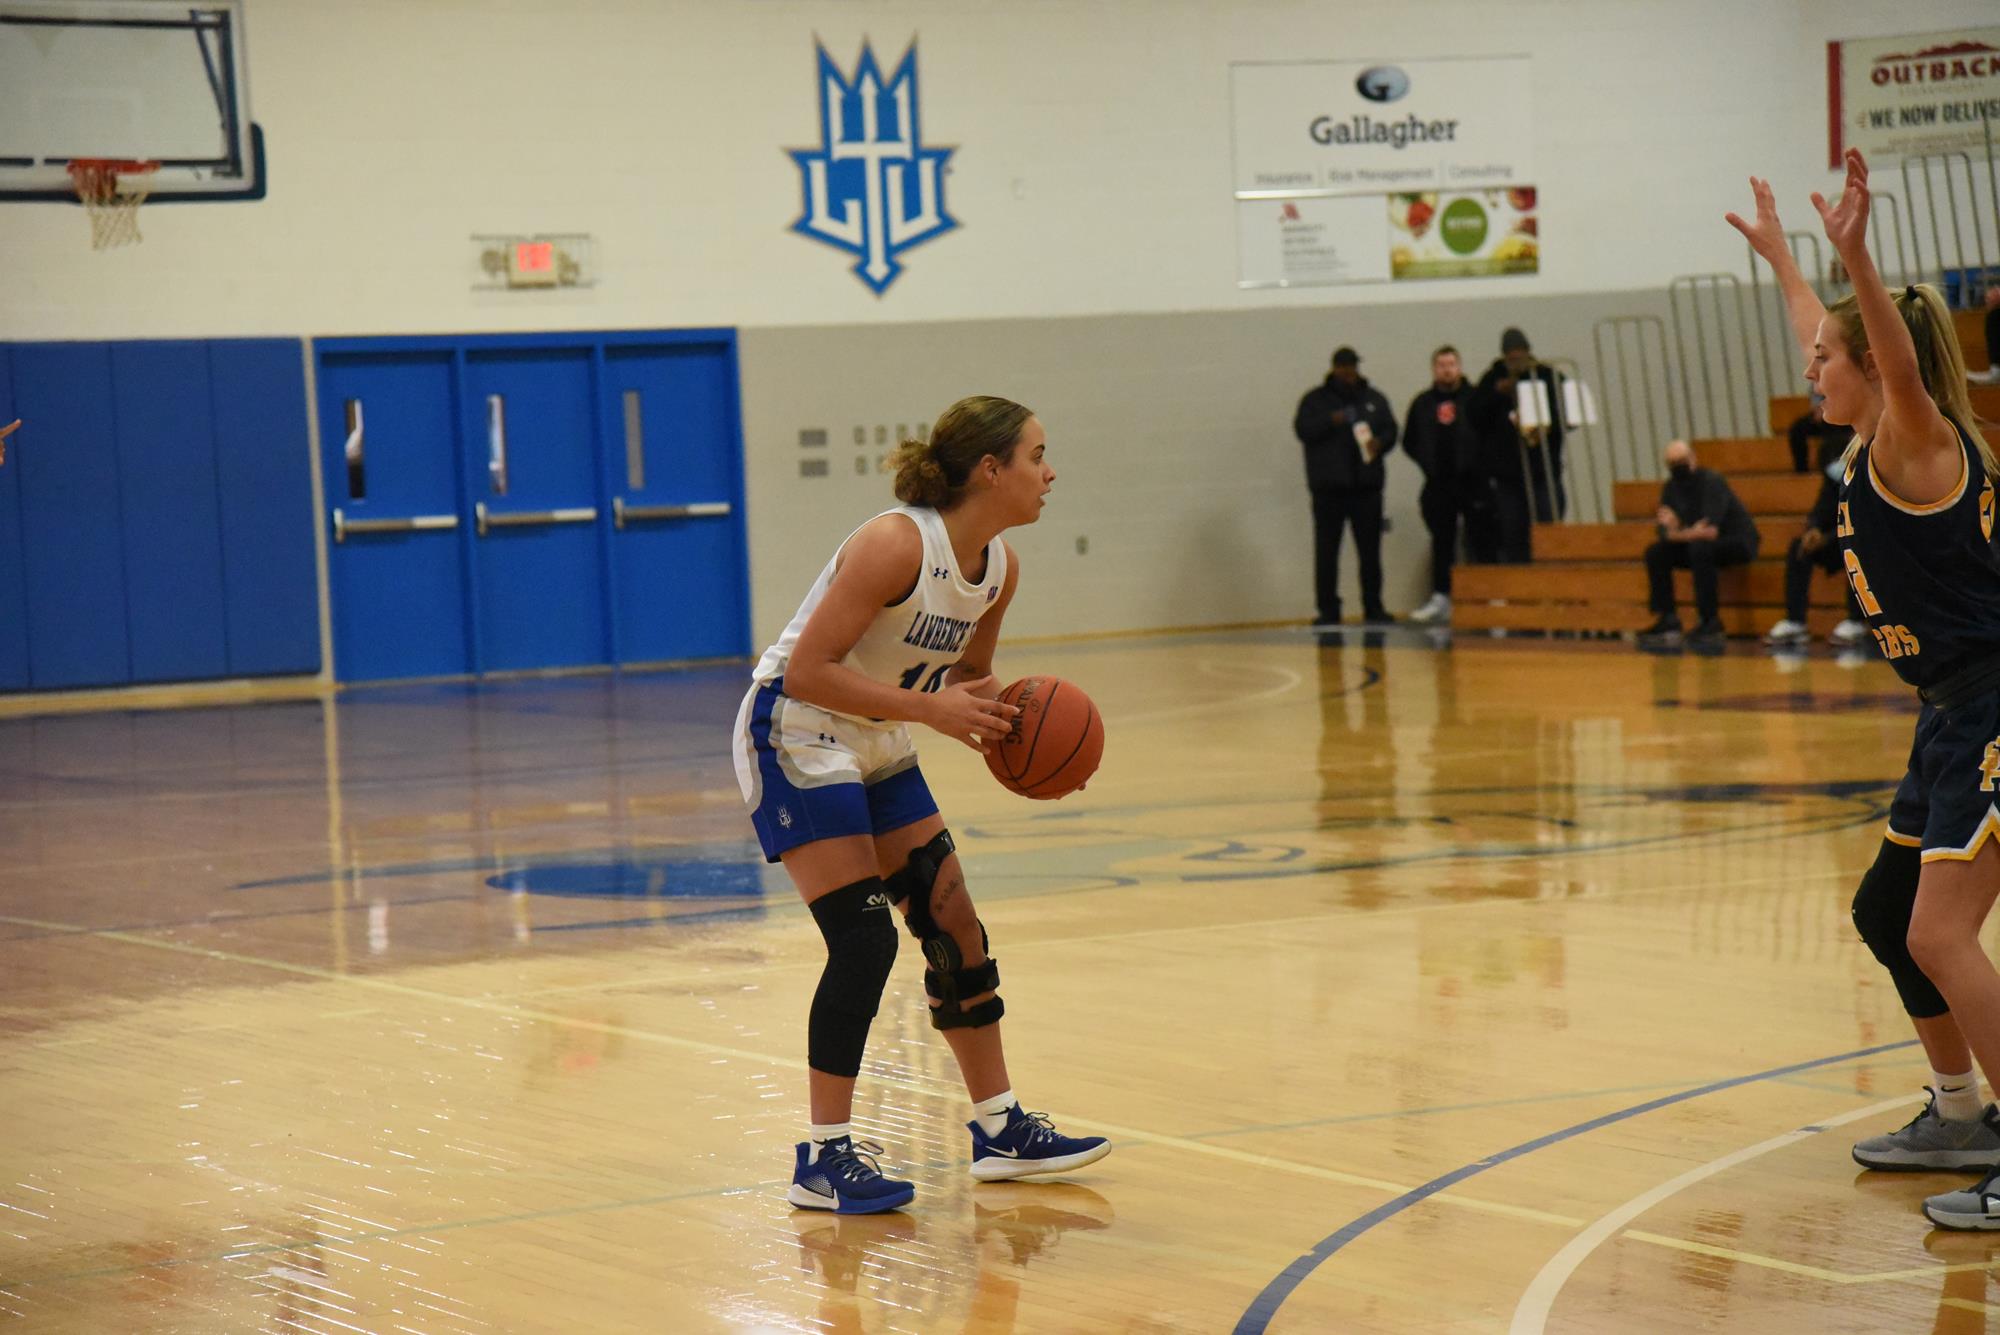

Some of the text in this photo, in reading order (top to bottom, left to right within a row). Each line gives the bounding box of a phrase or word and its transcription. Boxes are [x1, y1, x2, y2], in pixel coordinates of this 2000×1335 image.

[1310, 113, 1459, 149] Gallagher
[1868, 97, 2000, 129] WE NOW DELIVE
[903, 610, 972, 653] LAWRENCE
